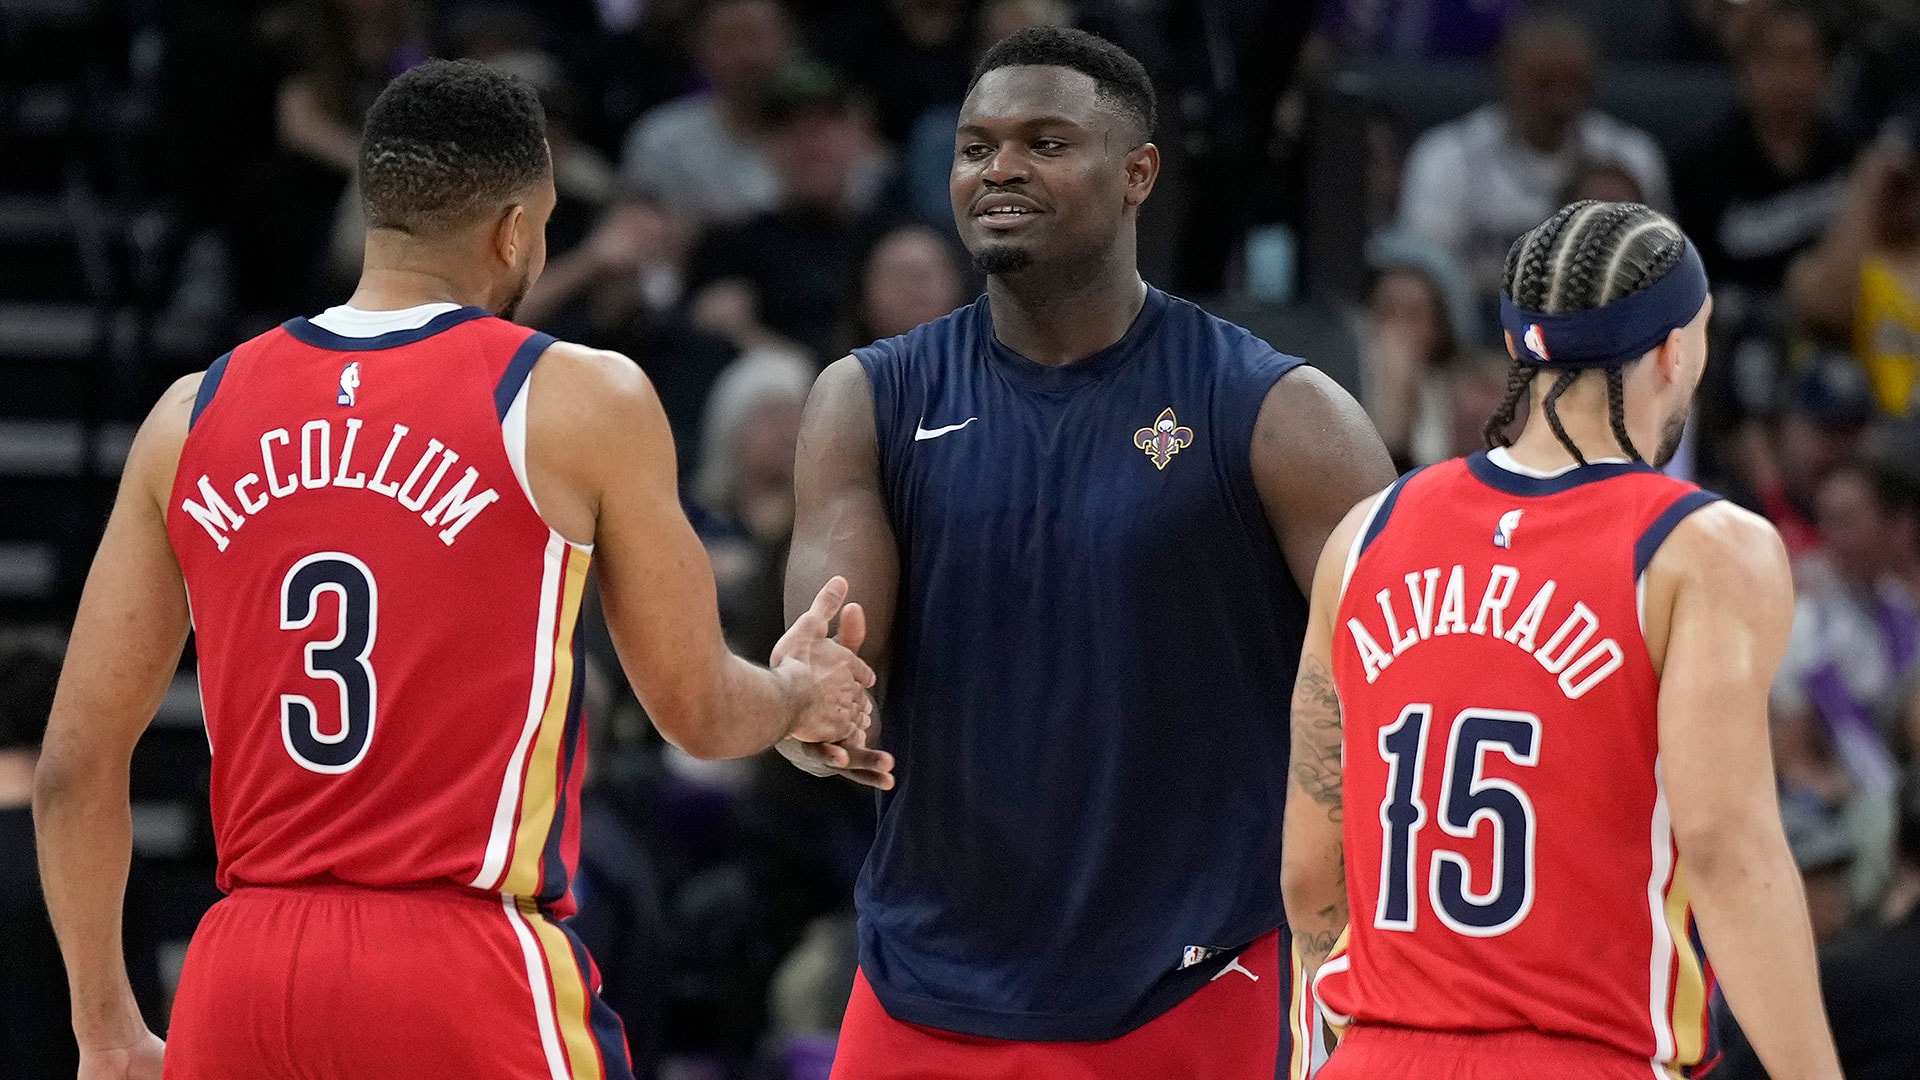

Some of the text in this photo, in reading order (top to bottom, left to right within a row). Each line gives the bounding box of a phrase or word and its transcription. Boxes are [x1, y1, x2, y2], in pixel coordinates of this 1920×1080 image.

[181, 418, 499, 552] McCOLLUM
[280, 552, 378, 775] 3
[1346, 564, 1624, 699] ALVARADO
[1374, 703, 1542, 937] 15
